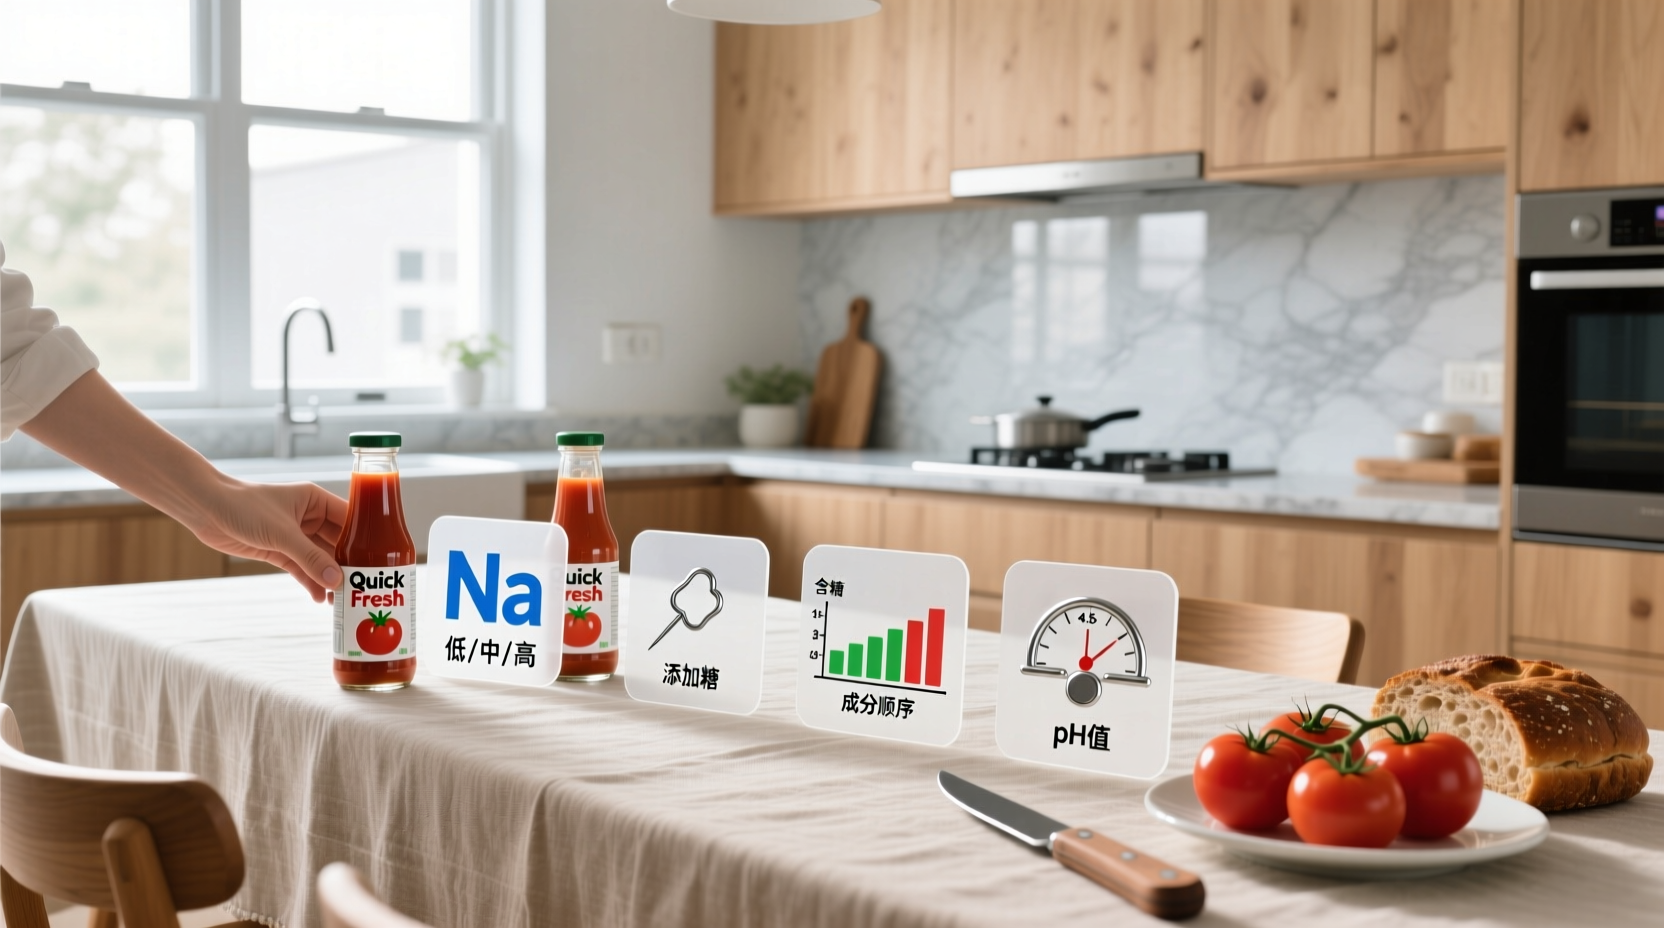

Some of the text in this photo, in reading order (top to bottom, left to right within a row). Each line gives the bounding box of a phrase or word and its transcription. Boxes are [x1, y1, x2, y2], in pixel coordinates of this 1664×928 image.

[350, 570, 405, 592] Quick
[445, 550, 542, 626] Na
[566, 568, 603, 585] uick
[351, 589, 405, 608] Fresh
[565, 585, 603, 602] resh
[445, 635, 537, 668] 低/中/高
[662, 662, 720, 691] 添加糖
[841, 691, 915, 719] 成分顺序
[1053, 723, 1111, 752] pH值
